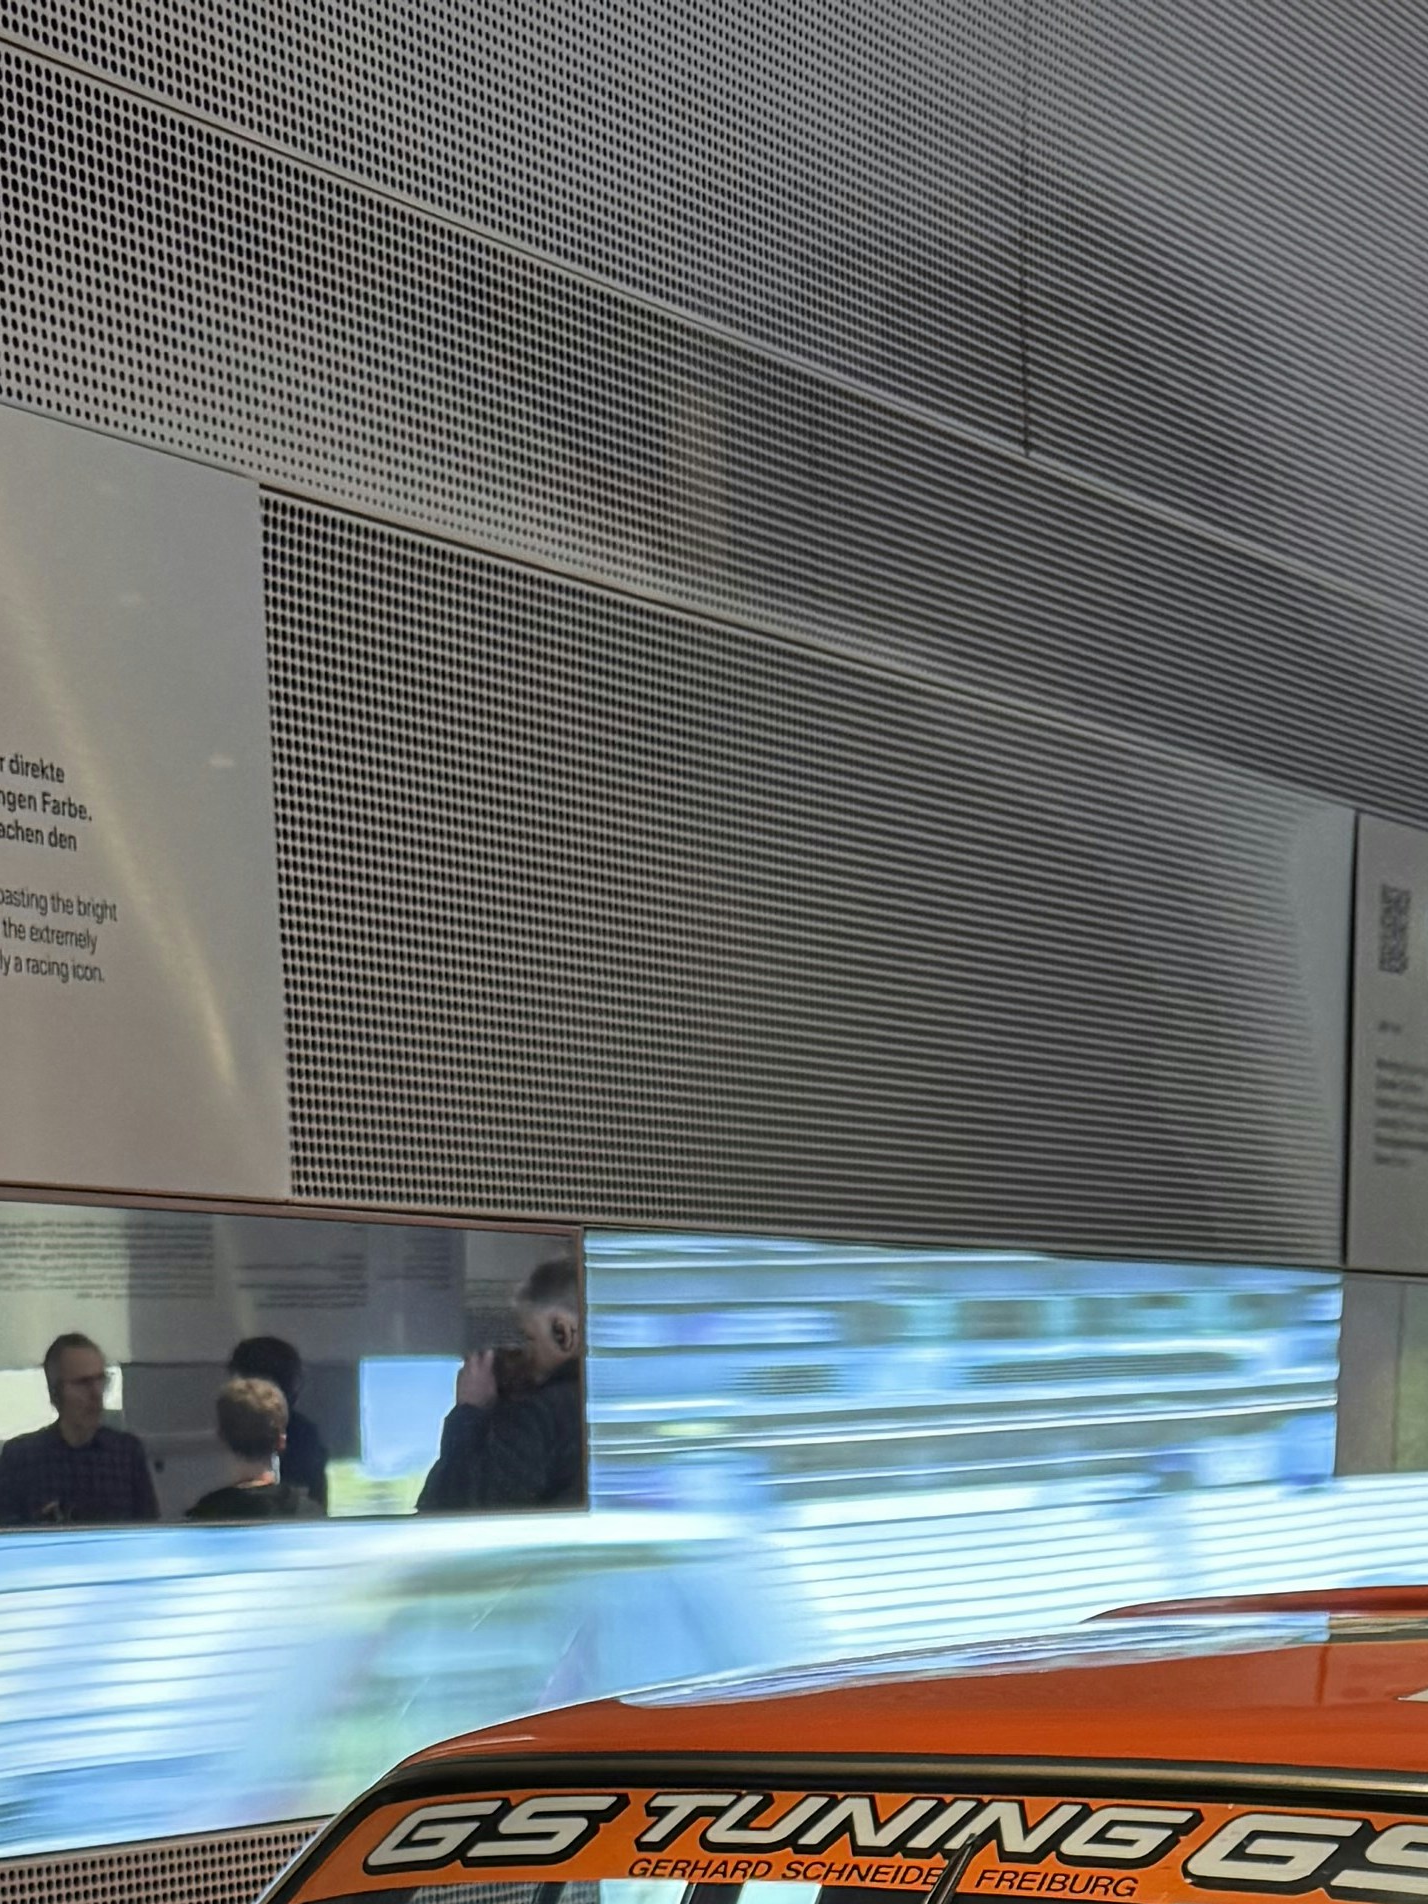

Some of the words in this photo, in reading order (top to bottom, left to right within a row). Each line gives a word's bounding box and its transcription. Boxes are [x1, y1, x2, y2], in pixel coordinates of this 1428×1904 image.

[8, 753, 65, 784] direkte
[41, 791, 93, 822] Farbe.
[47, 825, 77, 852] den
[363, 1792, 629, 1876] GS
[636, 1791, 1203, 1870] TUNING
[628, 1856, 772, 1882] GERHARD
[781, 1861, 944, 1890] SCHNEIDE
[975, 1869, 1139, 1899] FREIBURG
